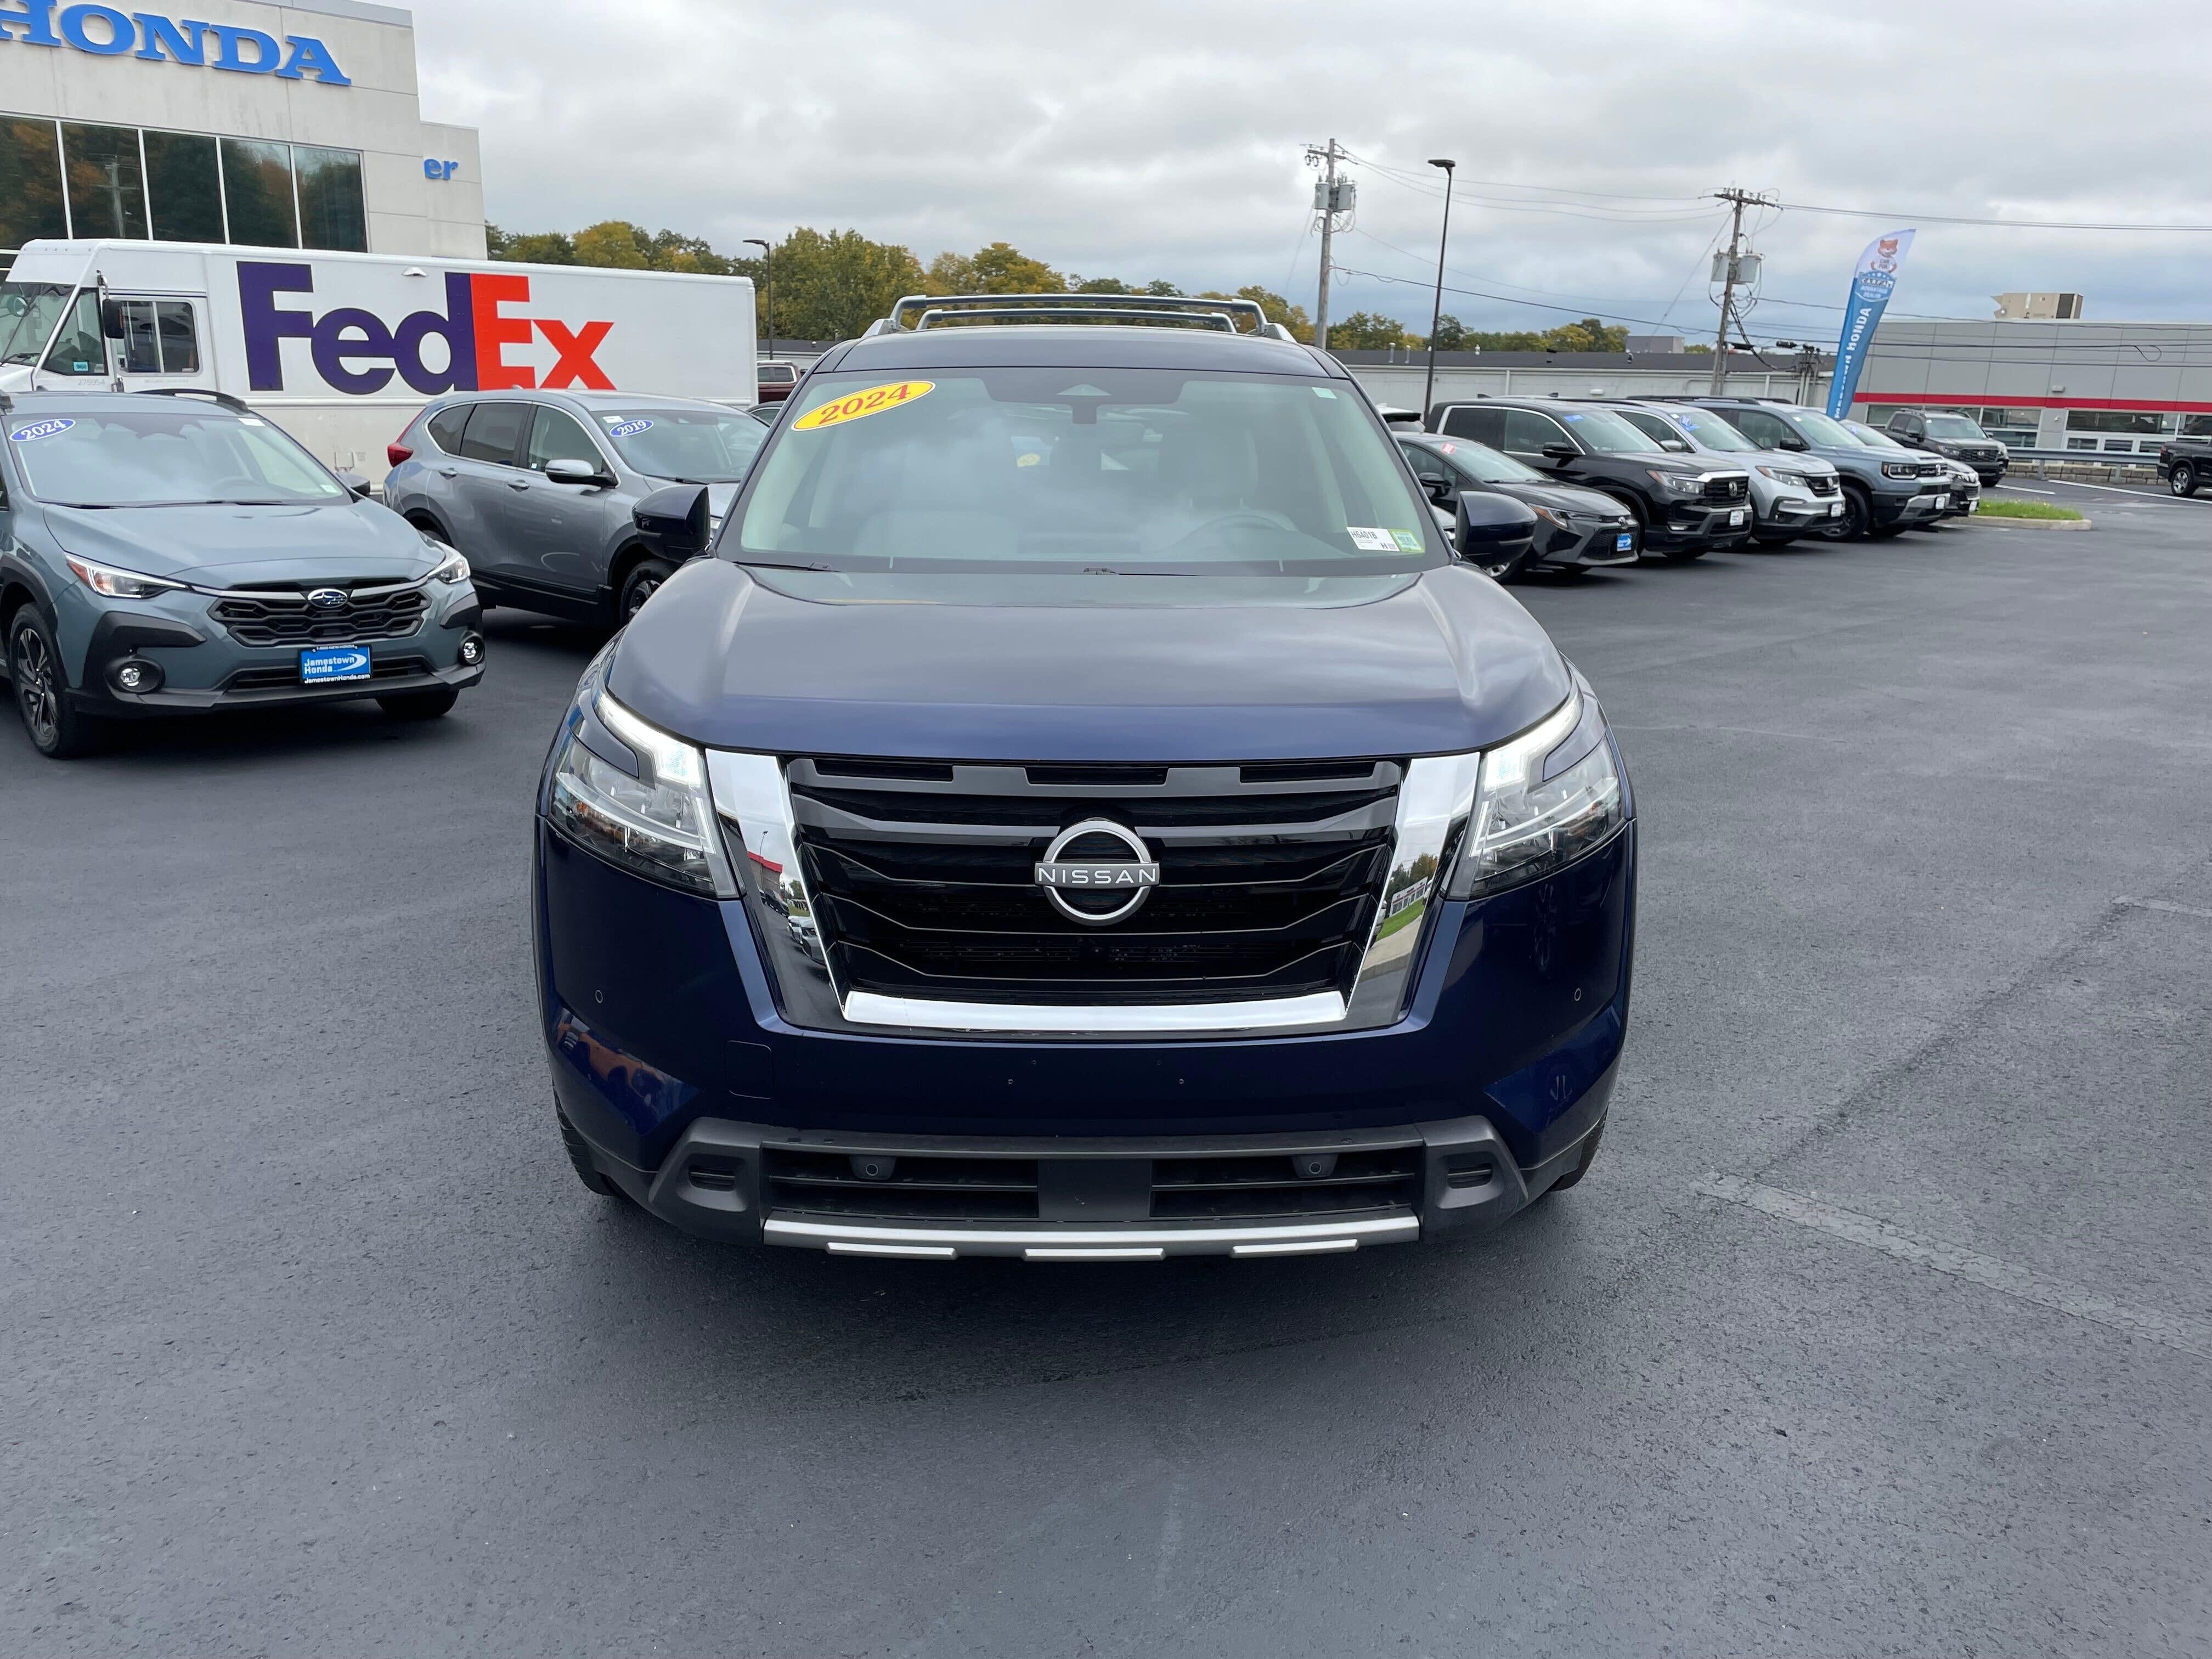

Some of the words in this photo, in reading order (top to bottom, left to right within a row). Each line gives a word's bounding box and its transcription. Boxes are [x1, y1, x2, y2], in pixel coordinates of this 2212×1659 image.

[0, 0, 352, 86] HONDA
[236, 261, 617, 395] FedEx
[1847, 307, 1872, 351] HONDA
[819, 385, 911, 425] 2024
[21, 420, 67, 439] 2024
[617, 421, 647, 435] 2019
[304, 656, 354, 667] Jamestown
[304, 664, 333, 674] Honda
[304, 674, 370, 684] JamestownHonda.com
[1039, 867, 1155, 884] NISSAN
